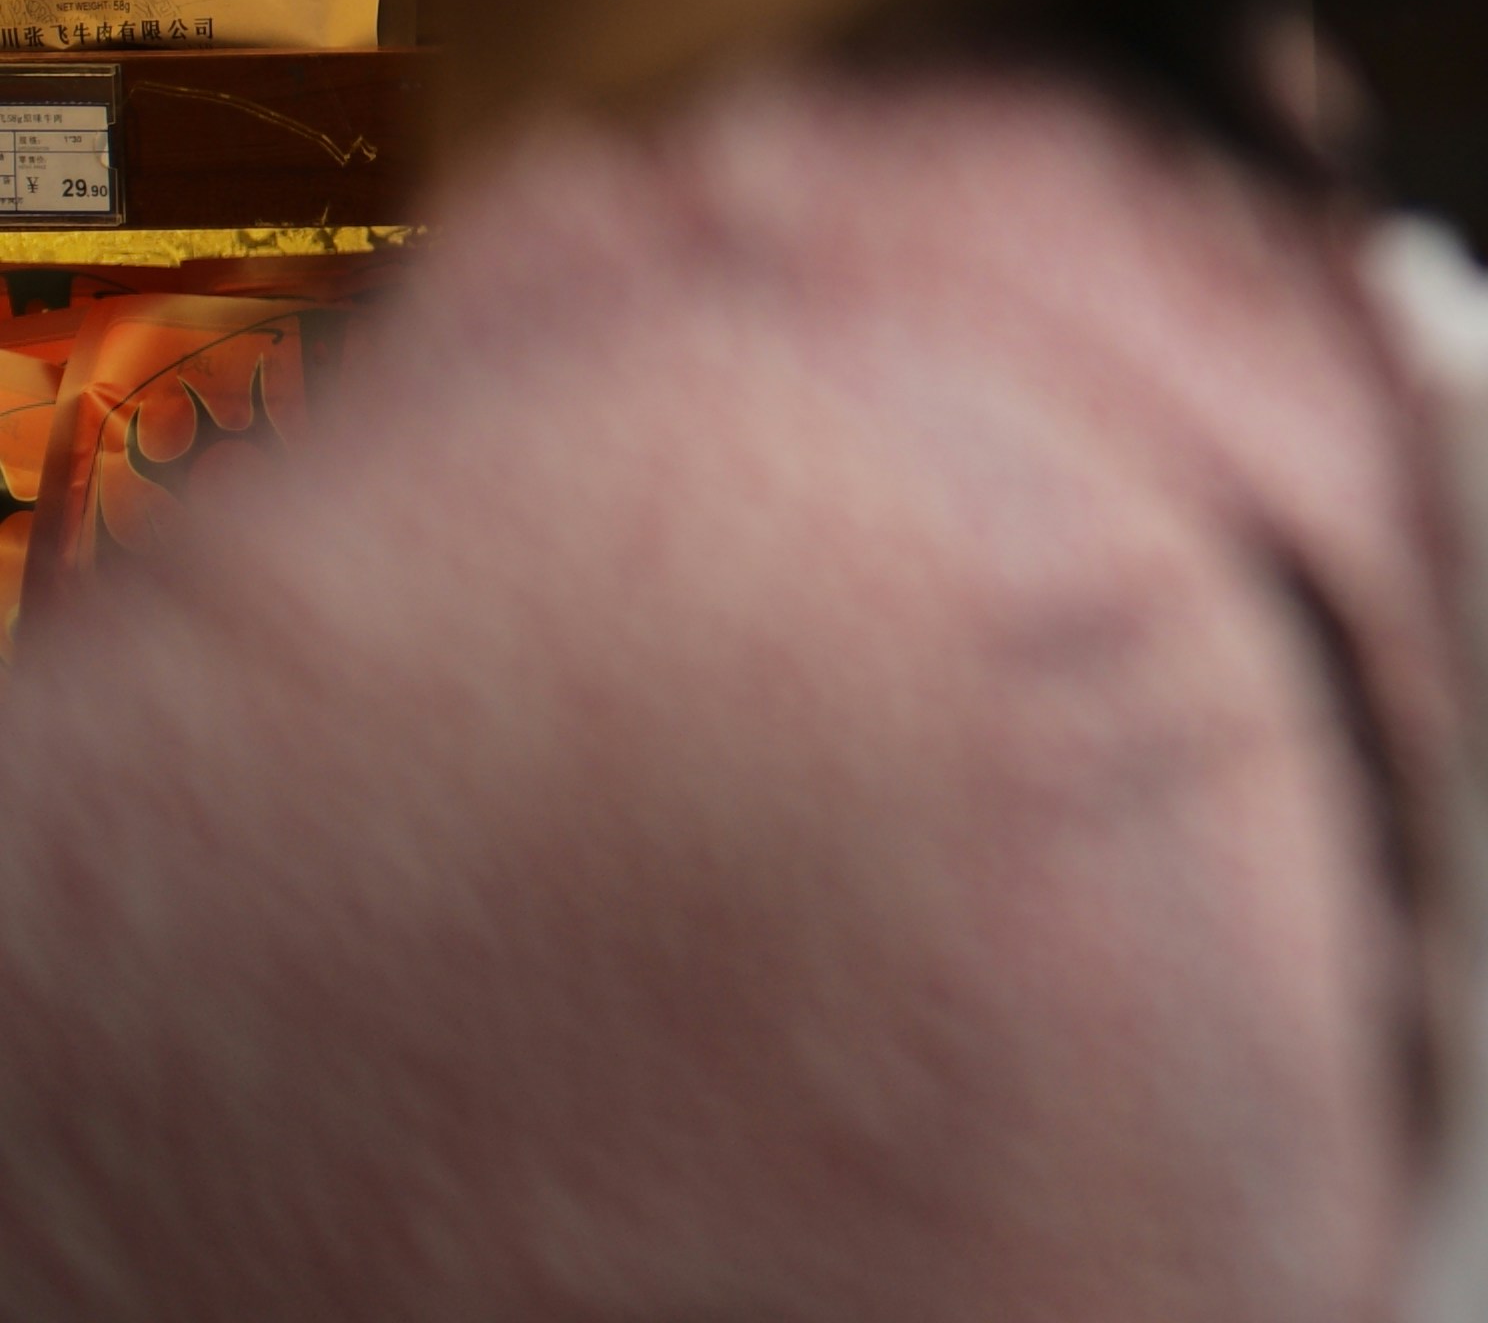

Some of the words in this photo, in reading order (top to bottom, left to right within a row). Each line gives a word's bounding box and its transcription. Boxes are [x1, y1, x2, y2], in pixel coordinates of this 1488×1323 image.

[56, 2, 74, 12] NET
[113, 0, 131, 12] 58g
[2, 17, 214, 49] 川张飞牛肉有限公司
[62, 179, 107, 197] 29.90
